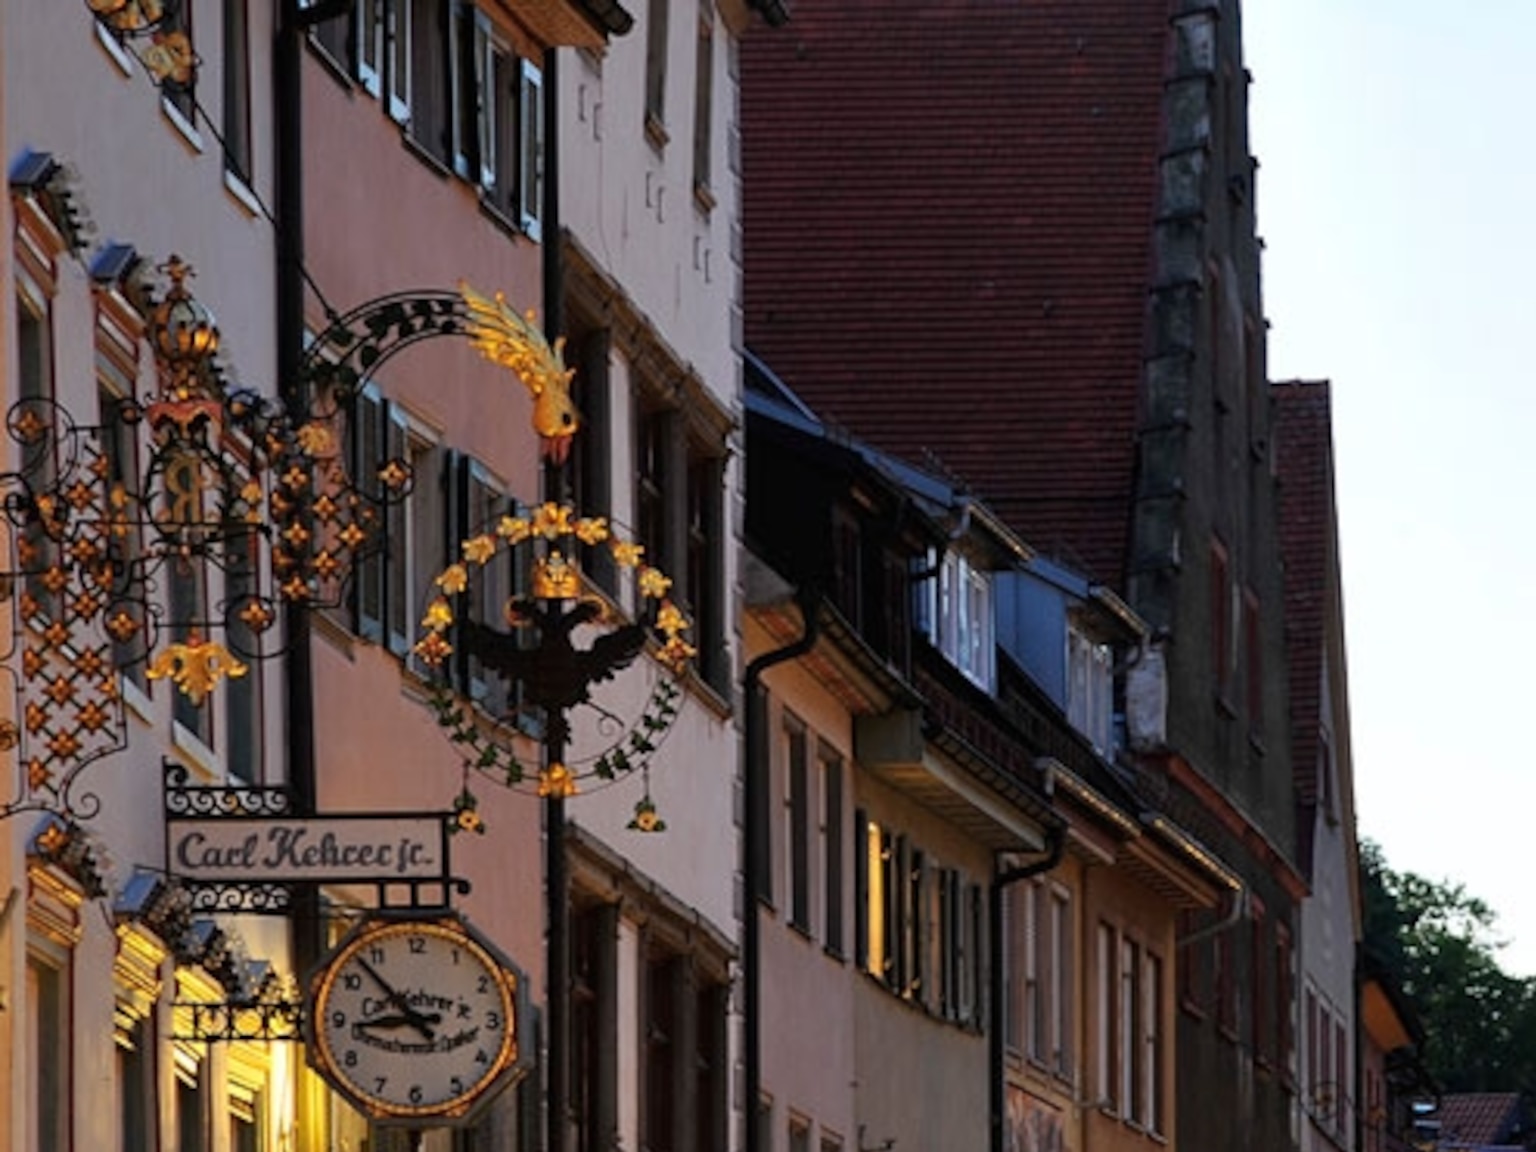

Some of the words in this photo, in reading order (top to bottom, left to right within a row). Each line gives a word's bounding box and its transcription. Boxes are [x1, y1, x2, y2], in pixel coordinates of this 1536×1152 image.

[177, 831, 259, 870] Carl
[263, 825, 392, 870] Kehrer
[397, 837, 434, 873] jr.
[408, 937, 427, 954] 12
[370, 949, 385, 965] 11
[451, 950, 459, 965] 1
[344, 974, 361, 990] 10
[477, 976, 489, 994] 2
[332, 1011, 345, 1028] 9
[485, 1011, 499, 1030] 3
[344, 1049, 358, 1067] 8
[474, 1049, 488, 1064] 4
[374, 1077, 387, 1094] 7
[449, 1077, 463, 1094] 5
[409, 1086, 422, 1103] 6
